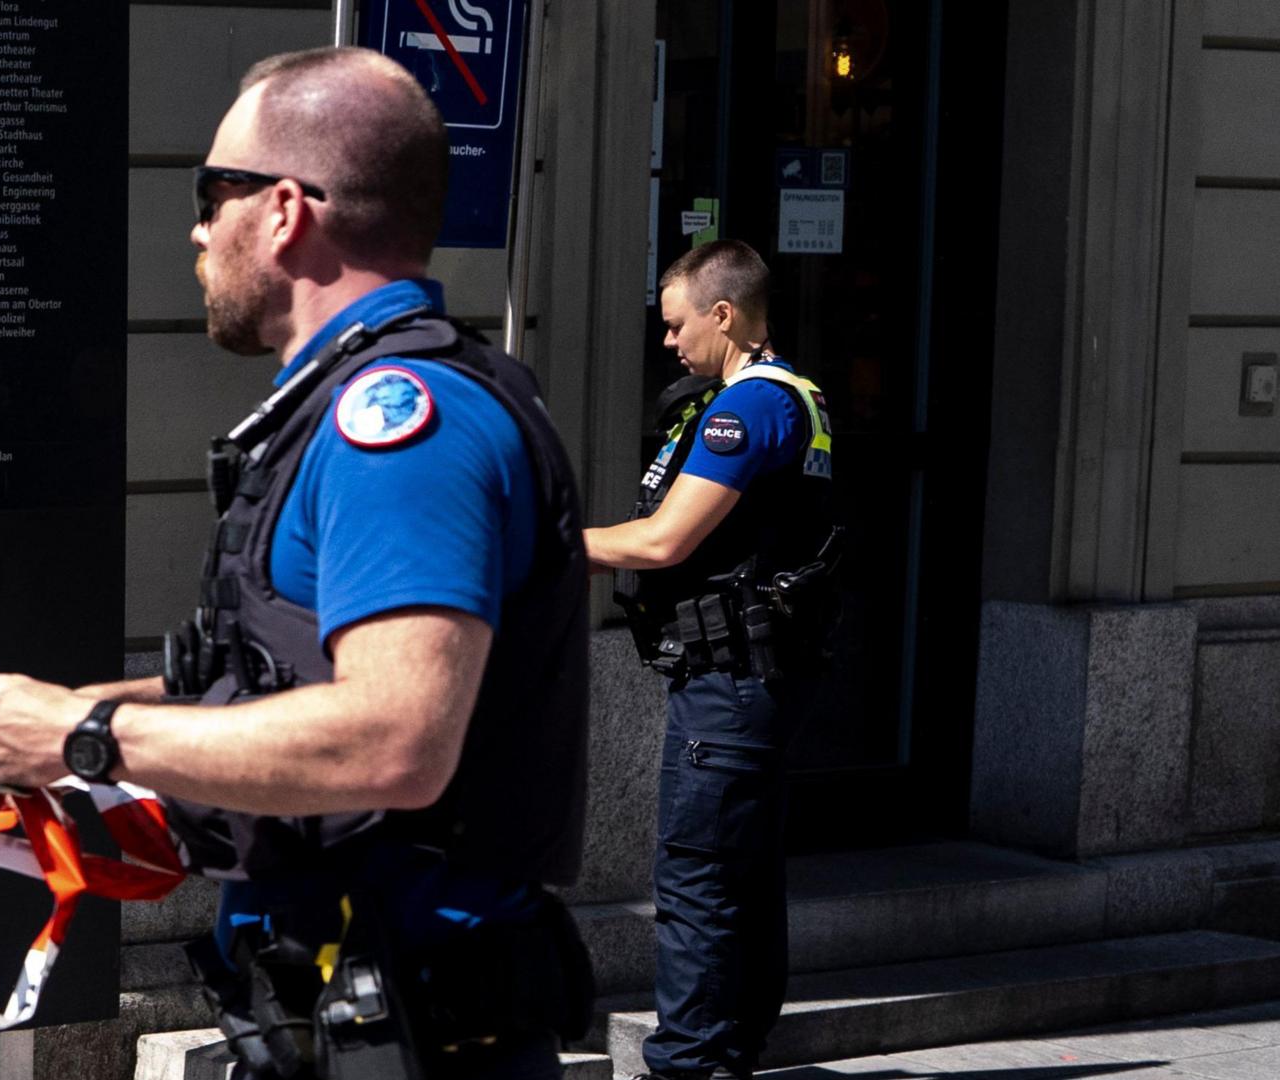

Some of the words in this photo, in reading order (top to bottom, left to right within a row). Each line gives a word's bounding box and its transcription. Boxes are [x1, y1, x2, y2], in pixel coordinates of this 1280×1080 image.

[14, 16, 59, 30] Lindengut
[31, 87, 64, 99] Theater
[24, 101, 68, 113] Tourismus
[450, 144, 486, 156] ucher-
[2, 171, 54, 183] Gesundheit
[2, 186, 56, 200] Engineering
[12, 301, 26, 309] am
[28, 298, 62, 310] Obertor
[704, 428, 742, 439] POLICE
